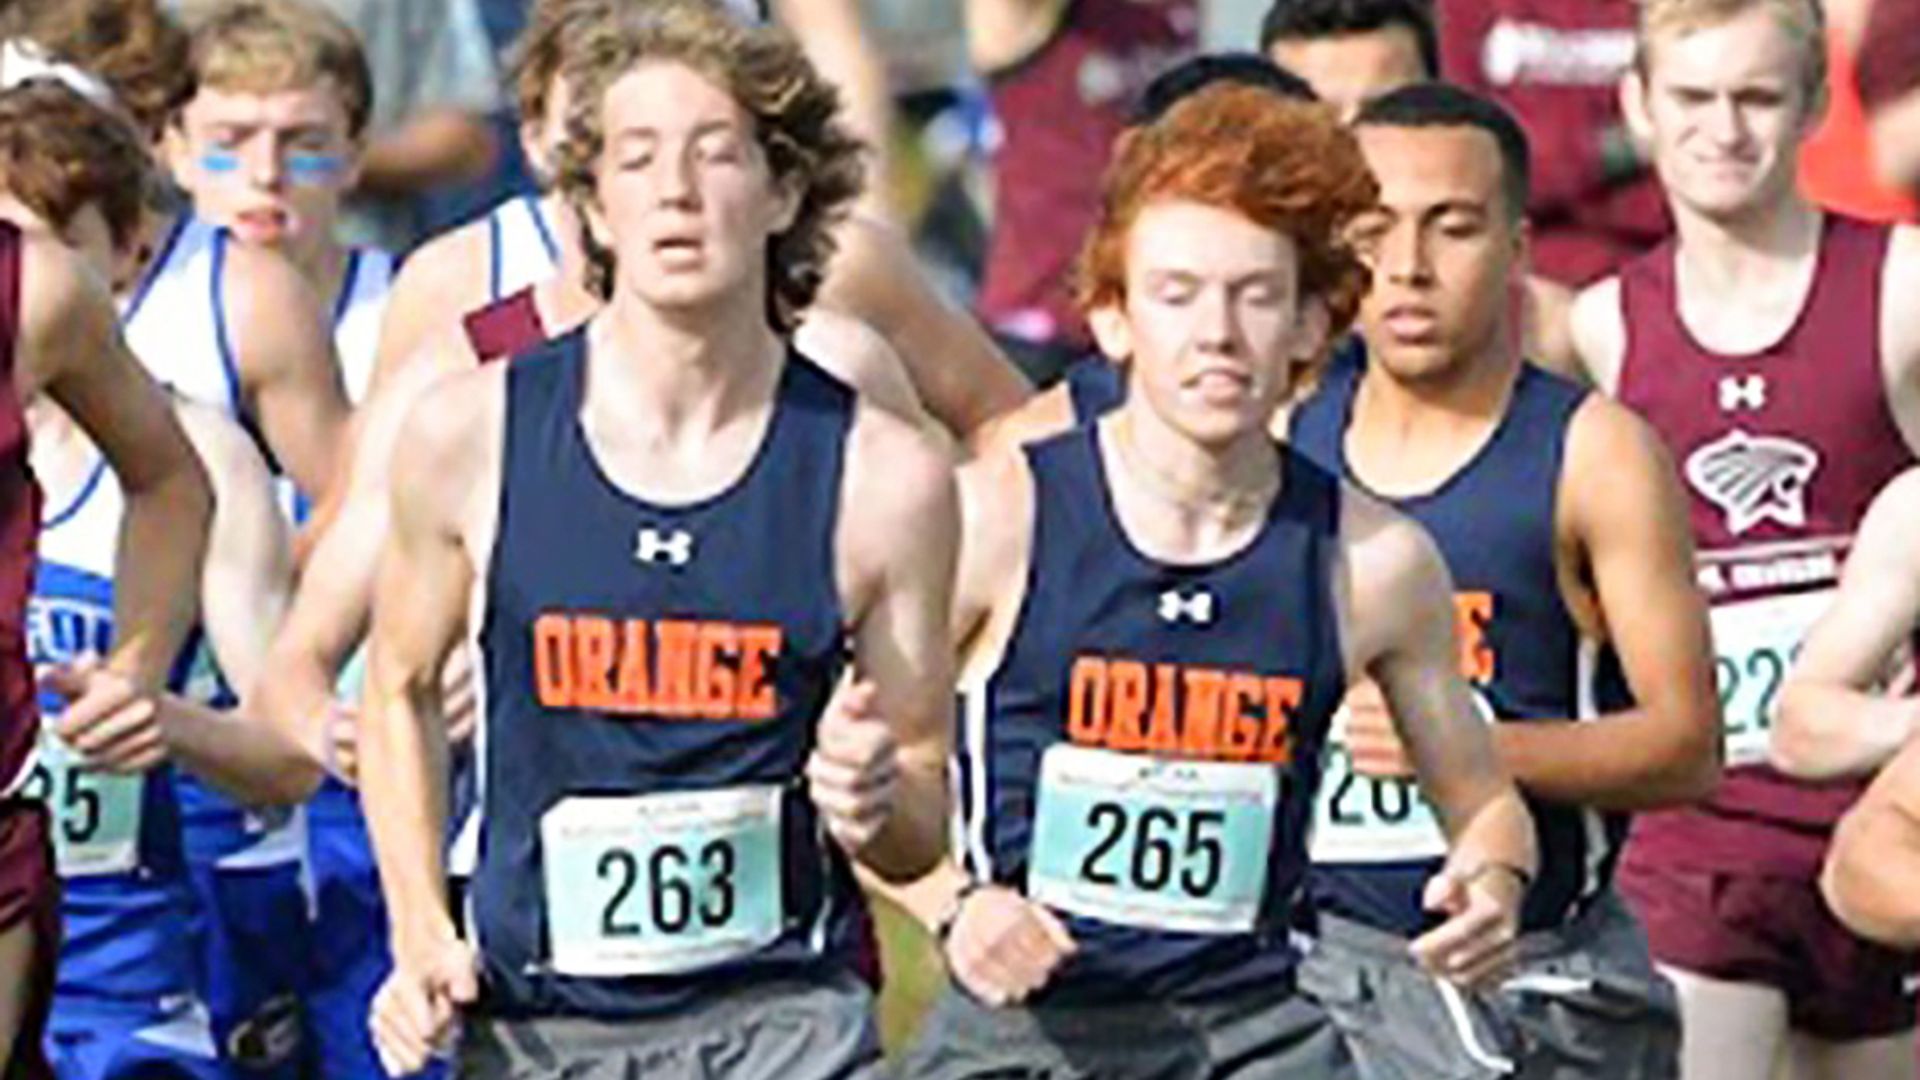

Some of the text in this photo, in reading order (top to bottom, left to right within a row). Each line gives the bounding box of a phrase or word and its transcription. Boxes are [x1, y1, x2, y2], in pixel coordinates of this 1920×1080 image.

[534, 614, 782, 718] ORANGE
[1069, 656, 1303, 762] ORANGE
[1716, 645, 1804, 733] 22
[597, 839, 735, 937] 263
[1081, 802, 1226, 898] 265
